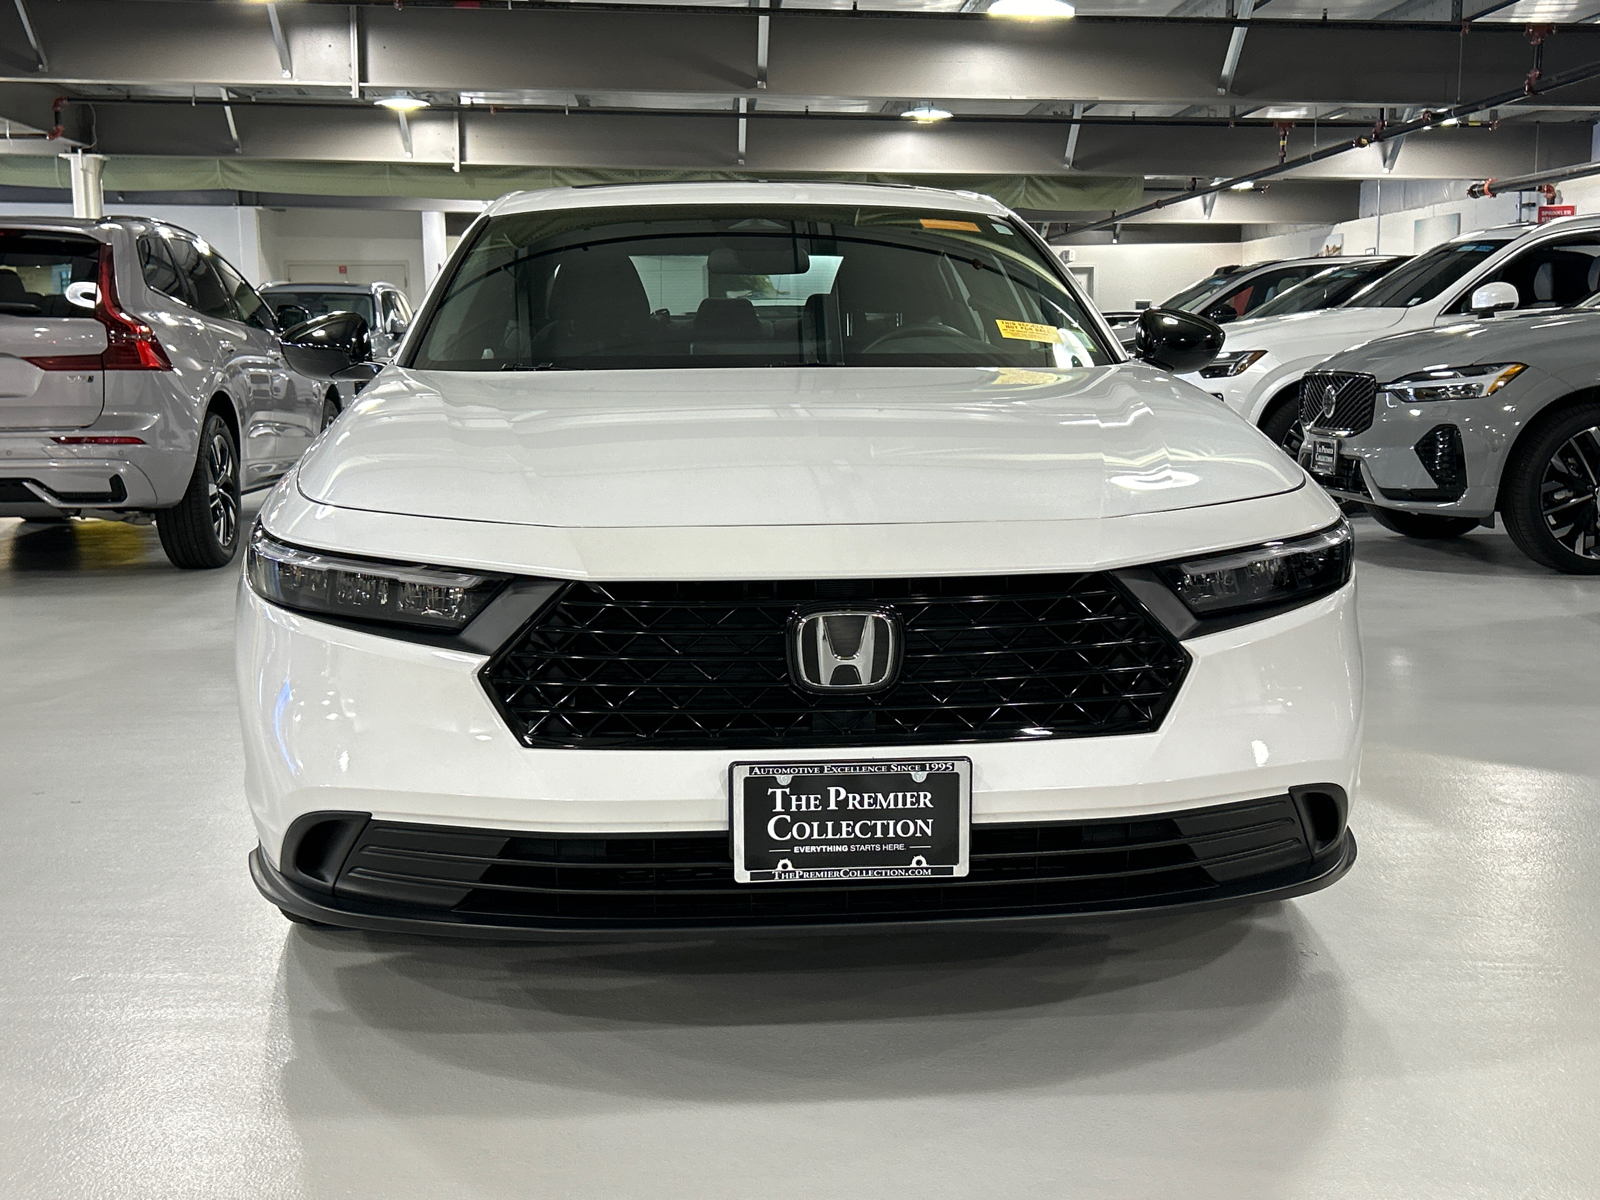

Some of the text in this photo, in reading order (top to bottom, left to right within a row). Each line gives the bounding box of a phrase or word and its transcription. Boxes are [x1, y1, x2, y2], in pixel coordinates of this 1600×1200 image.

[751, 762, 953, 775] AUTOMOTIVE EXCELLENCE SINCE 1995
[767, 786, 934, 812] THE PREMIER
[767, 814, 934, 841] COLLECTION
[793, 843, 907, 853] EVERYTHING STARTS HERE.
[772, 868, 932, 880] THEPREMIERCOLLECTION.COM
